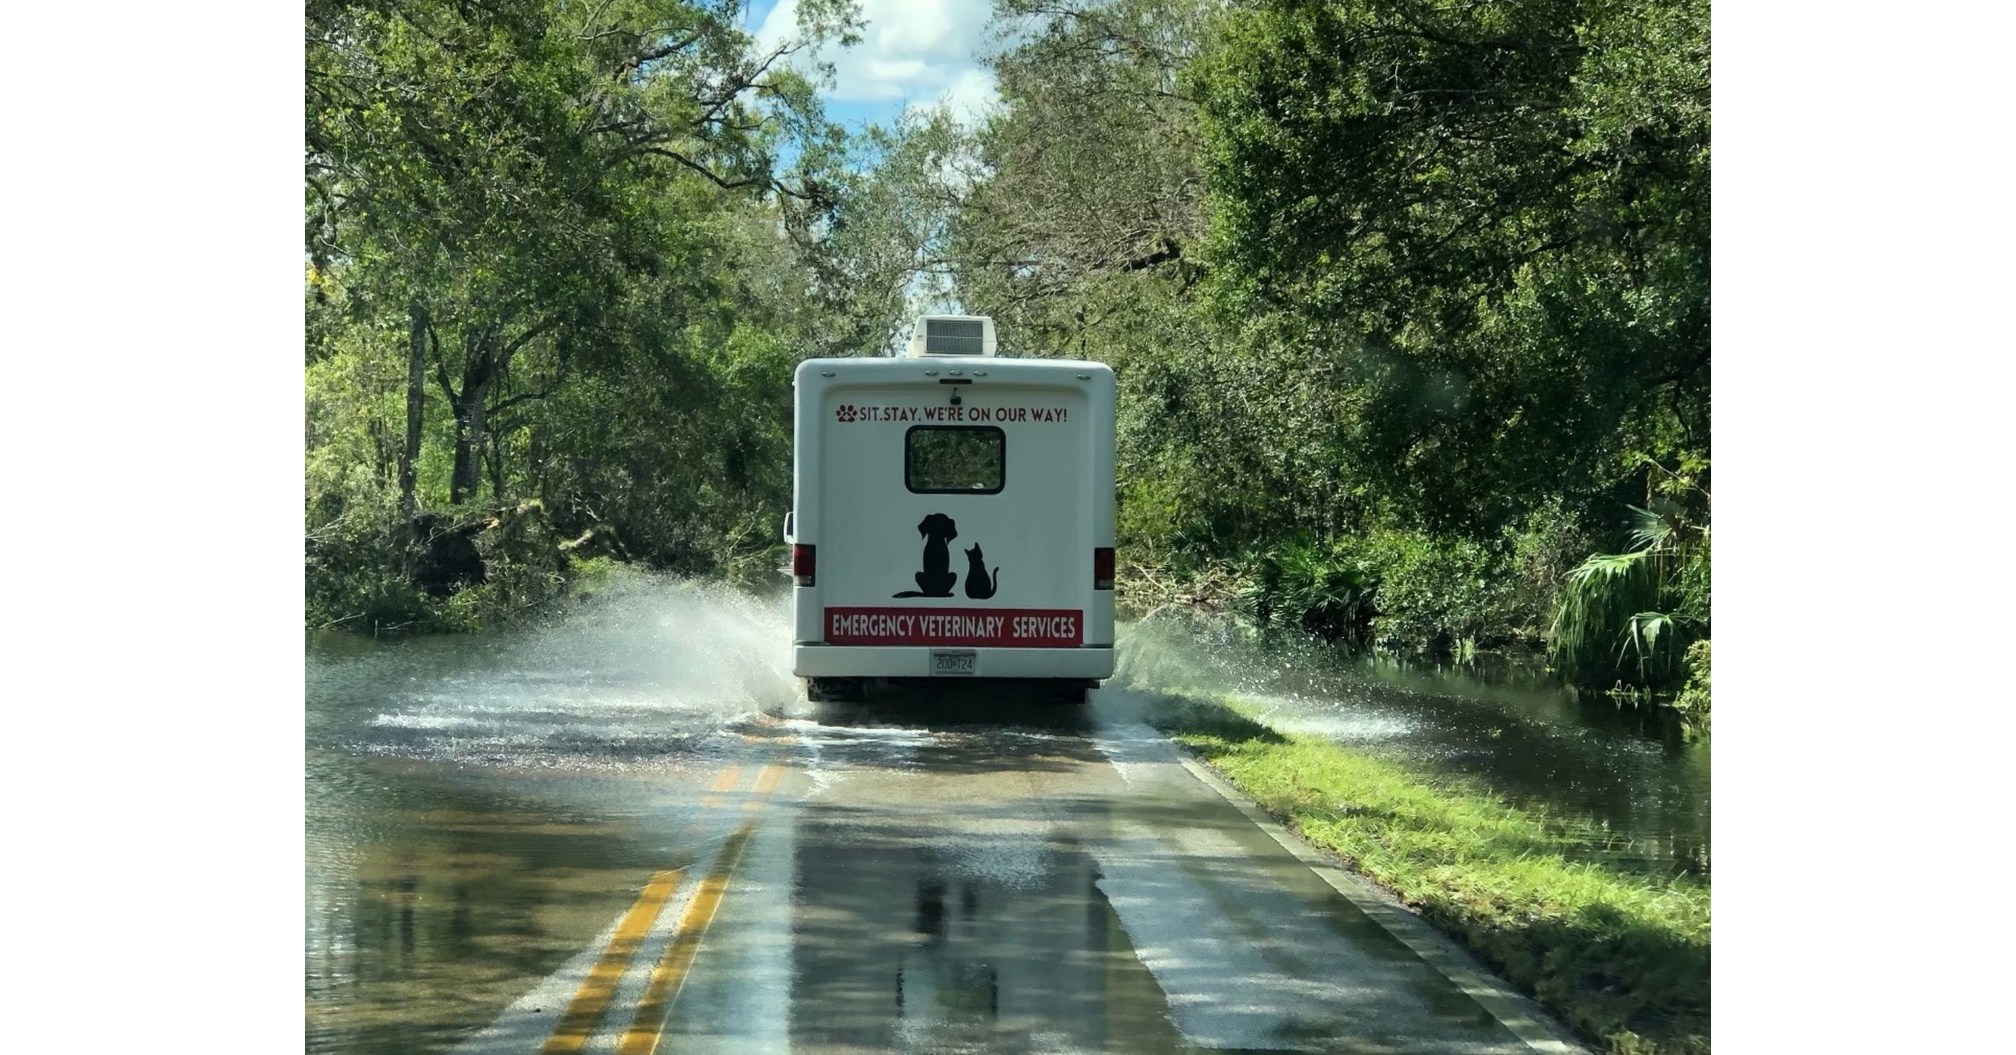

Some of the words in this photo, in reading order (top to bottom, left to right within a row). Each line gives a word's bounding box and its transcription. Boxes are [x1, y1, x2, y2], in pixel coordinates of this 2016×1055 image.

[924, 407, 964, 422] WE'RE
[968, 407, 990, 422] ON
[995, 407, 1027, 422] OUR
[1031, 408, 1067, 423] WAY!
[832, 614, 916, 637] EMERGENCY
[919, 615, 1005, 638] VETERINARY
[1012, 616, 1075, 639] SERVICES
